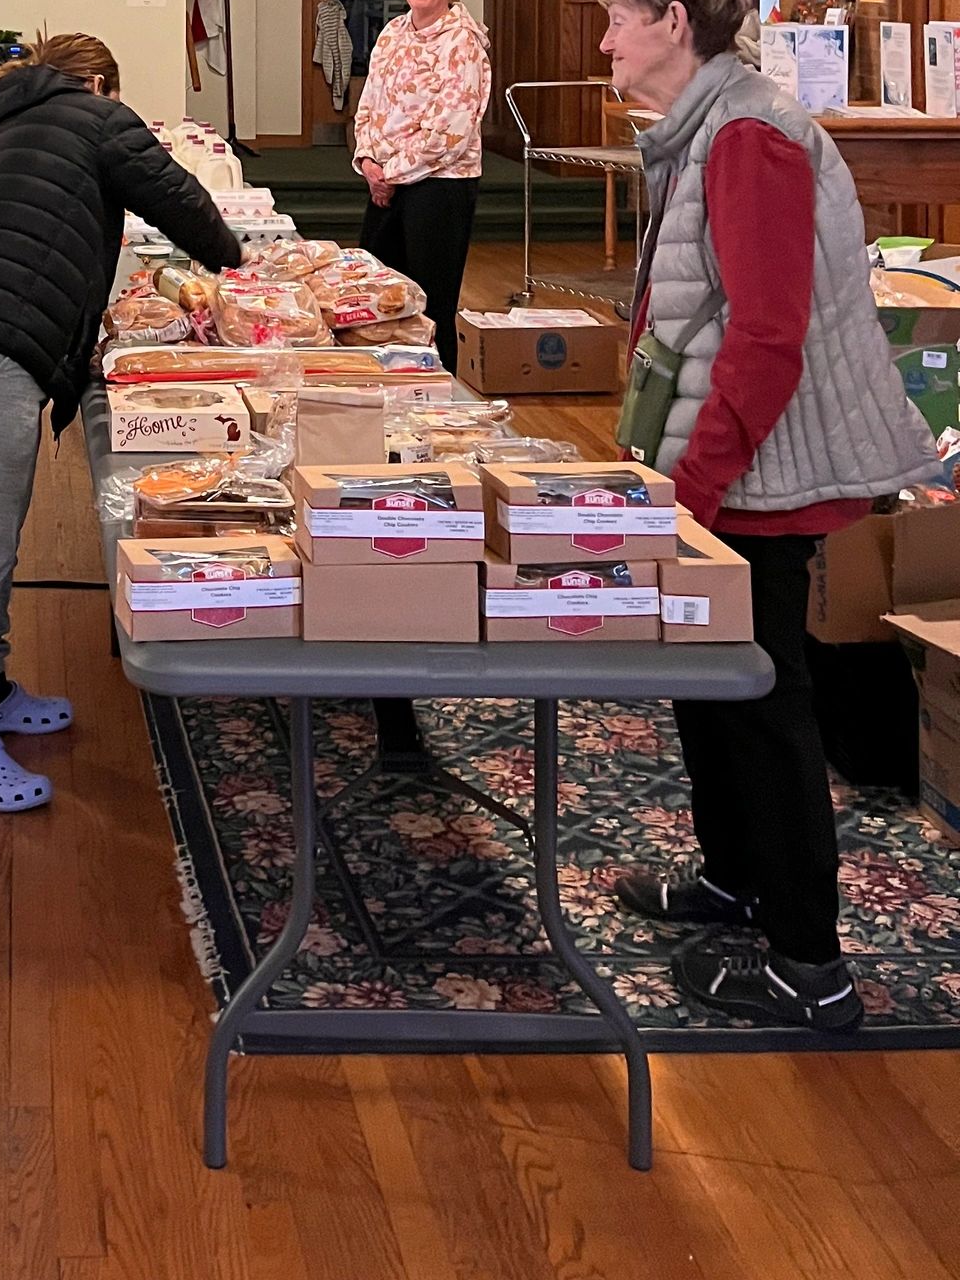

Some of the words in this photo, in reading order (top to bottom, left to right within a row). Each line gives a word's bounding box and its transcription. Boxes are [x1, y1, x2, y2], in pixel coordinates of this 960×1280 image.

[125, 415, 187, 440] Home
[385, 498, 415, 508] SUNSET
[584, 494, 614, 504] SUNSET
